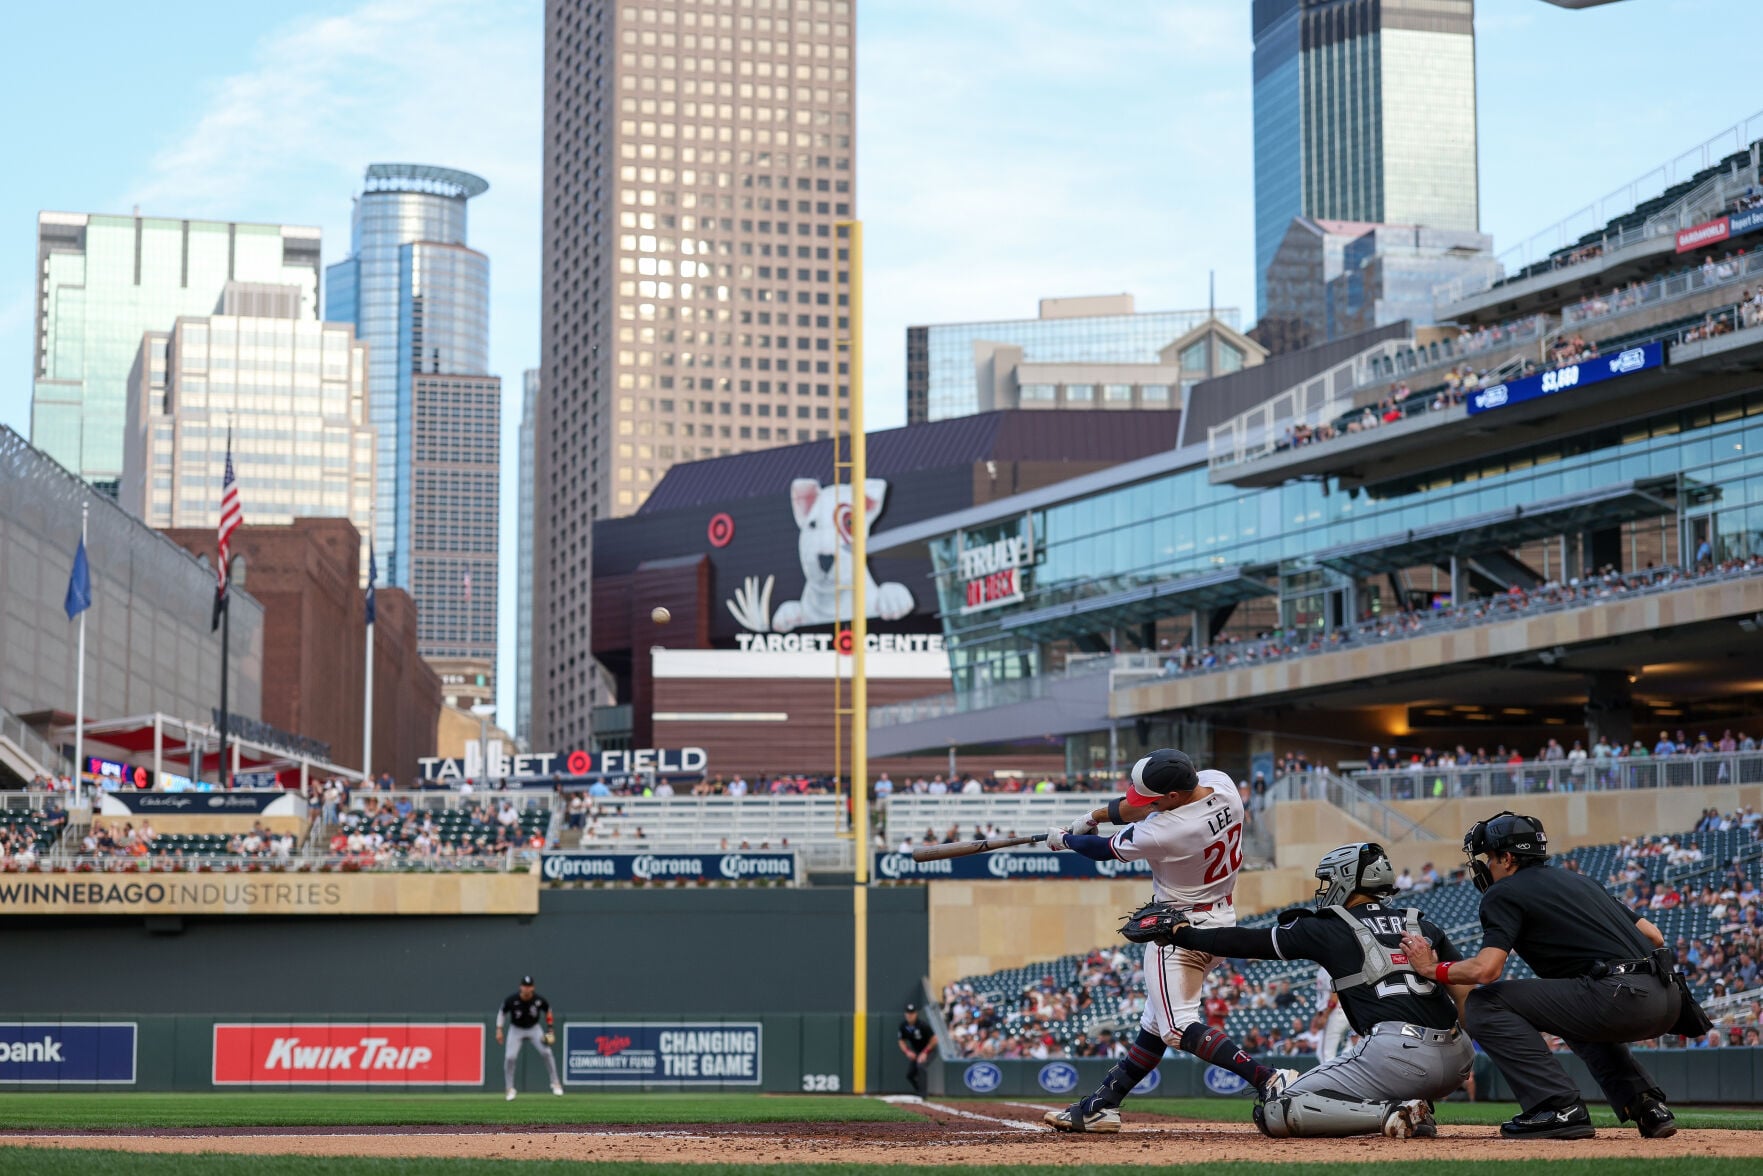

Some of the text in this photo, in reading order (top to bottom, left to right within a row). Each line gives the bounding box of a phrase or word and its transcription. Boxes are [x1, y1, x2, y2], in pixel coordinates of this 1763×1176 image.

[961, 535, 1023, 579] TRULY
[735, 633, 947, 652] TARGET CENTE
[418, 747, 707, 779] TAGET FIELD
[1208, 807, 1232, 836] LEE
[1203, 822, 1243, 885] 22
[544, 854, 791, 880] Corona Corona Corona
[988, 853, 1060, 878] Corona
[0, 883, 341, 905] WINNEBAGO INDUSTRIES
[594, 1034, 632, 1057] Twins
[659, 1031, 756, 1053] CHANGING
[569, 1055, 657, 1068] COMMUNITY FUND
[662, 1054, 754, 1076] THE GAME
[802, 1074, 840, 1092] 328
[971, 1067, 996, 1087] Ford
[1046, 1067, 1072, 1087] Ford
